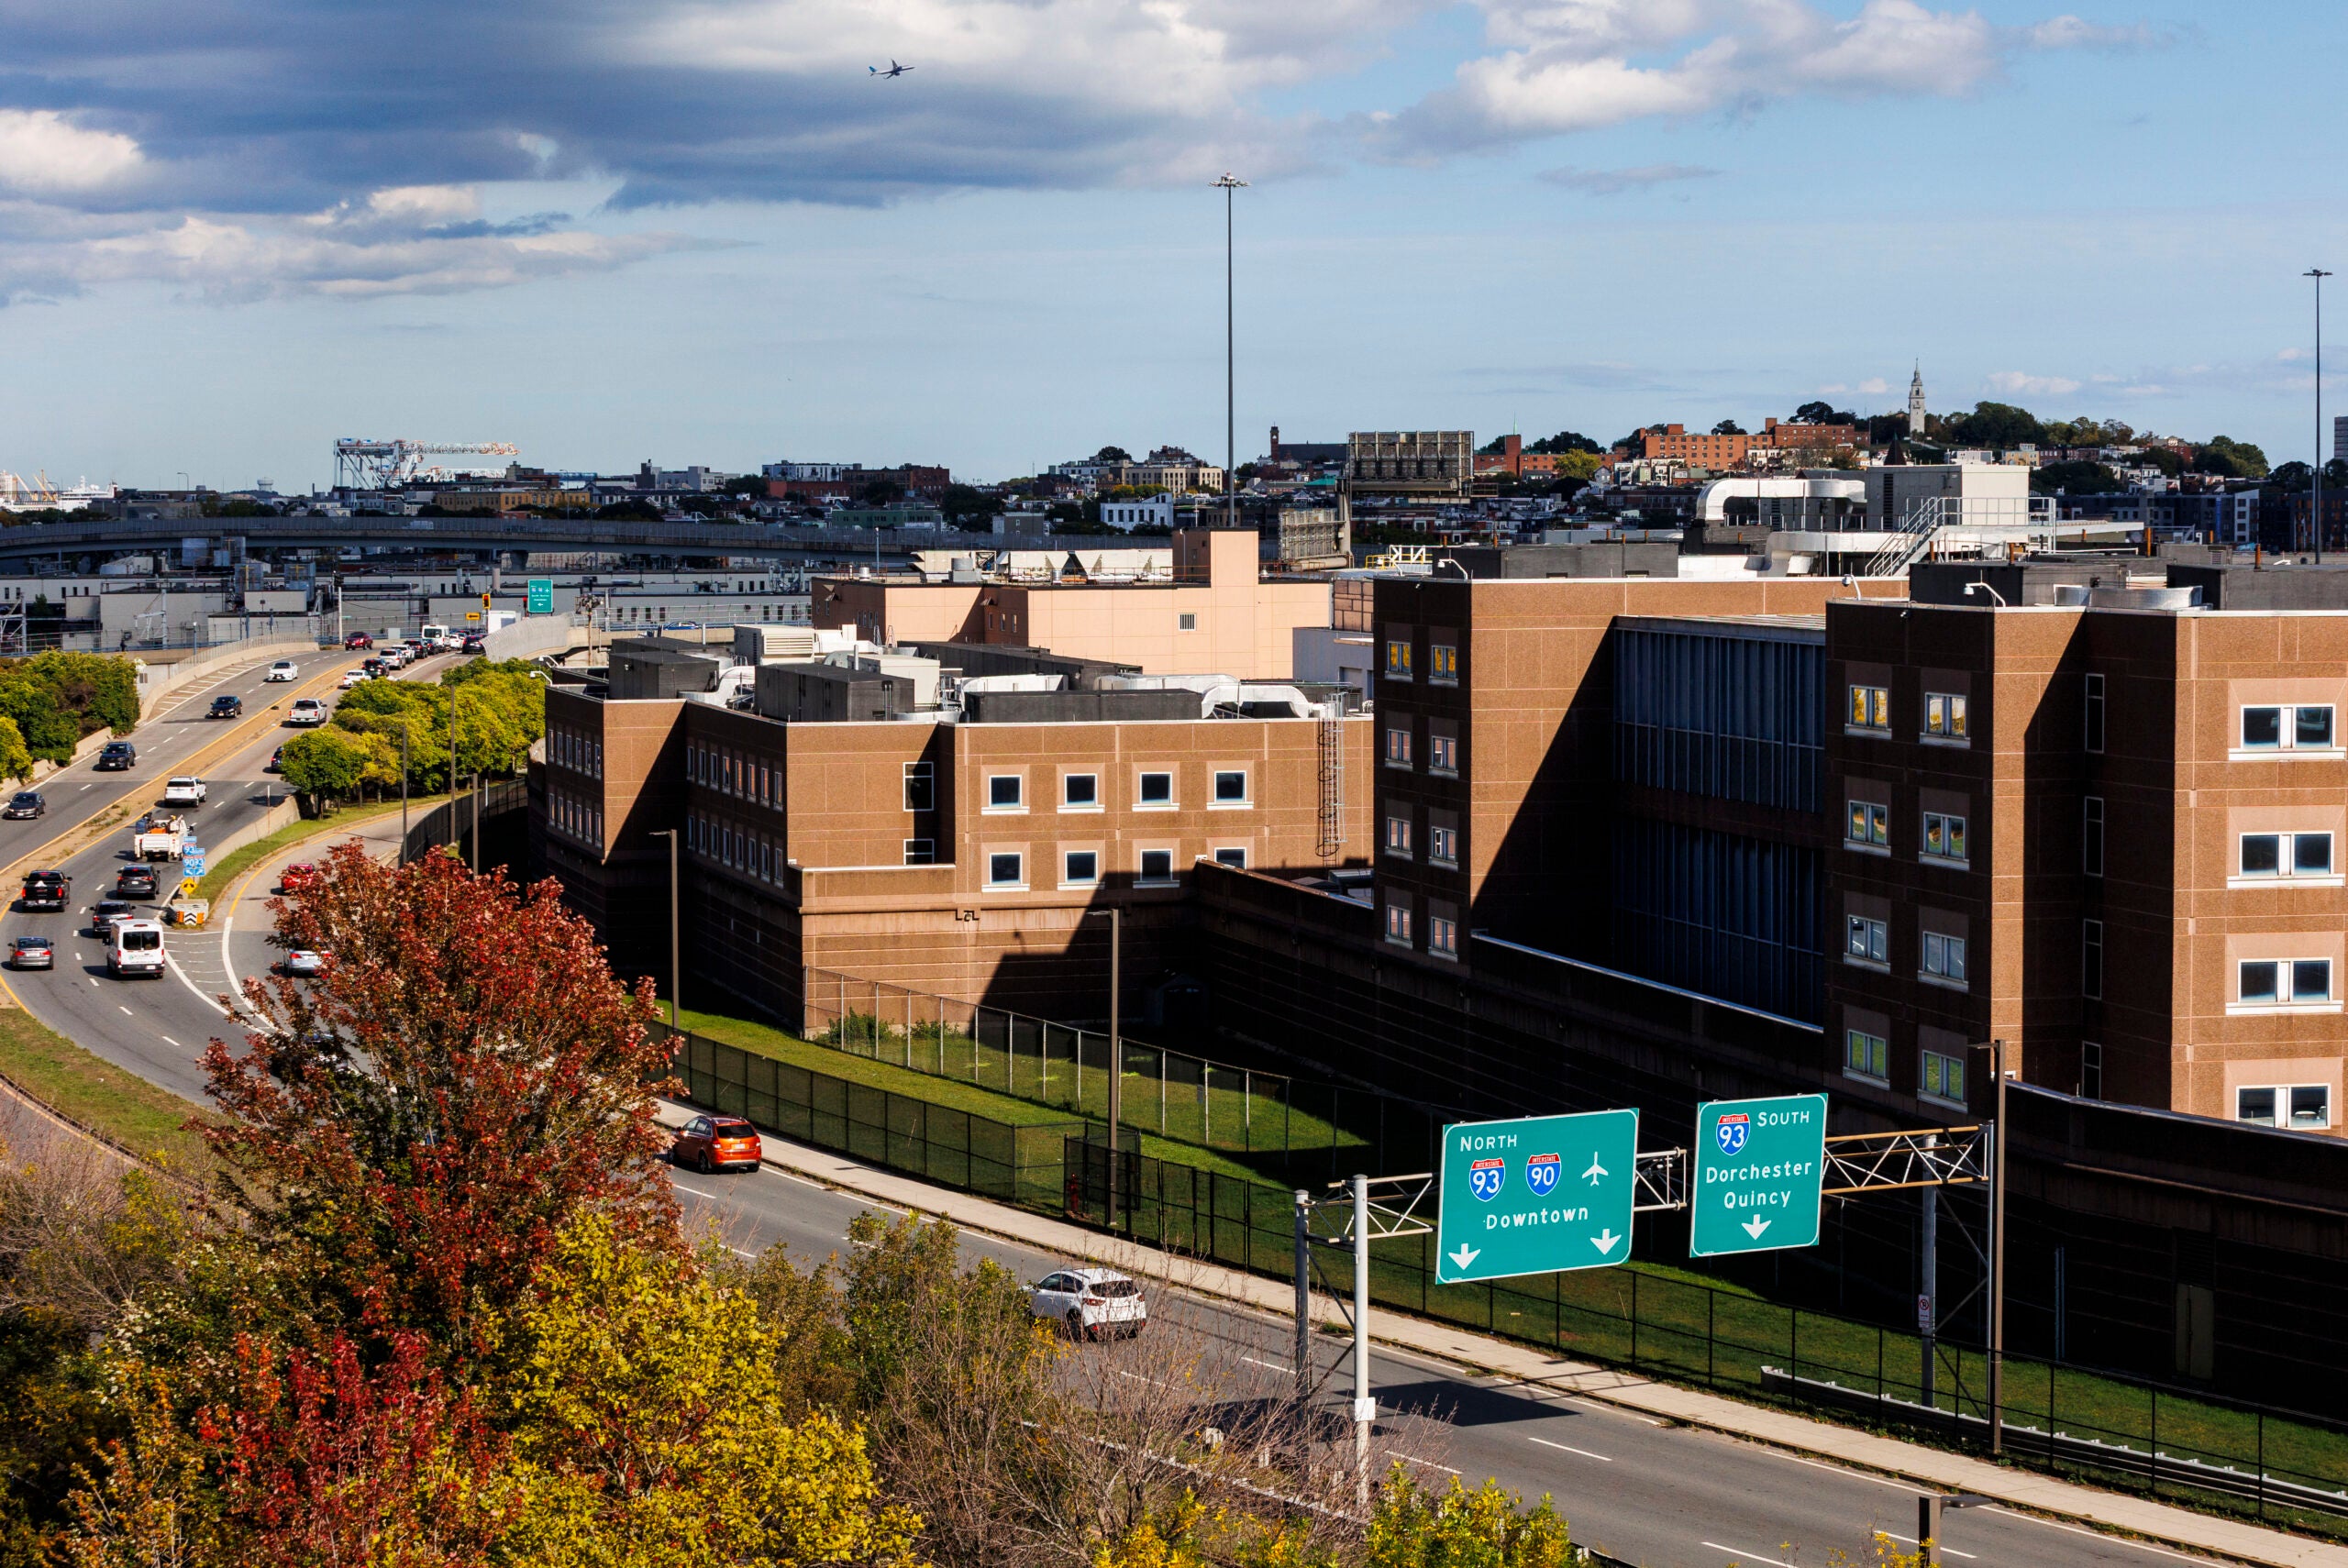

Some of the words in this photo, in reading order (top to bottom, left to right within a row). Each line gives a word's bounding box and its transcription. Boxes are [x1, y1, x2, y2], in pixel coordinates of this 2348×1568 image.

[1757, 1110, 1810, 1127] SOUTH
[1460, 1134, 1517, 1152] NORTH
[1719, 1125, 1744, 1148] 93
[1475, 1160, 1500, 1168] INTERSTATE
[1706, 1161, 1812, 1184] Dorchester
[1473, 1169, 1500, 1194] 93
[1531, 1165, 1555, 1187] 90
[1723, 1190, 1791, 1209] Quincy
[1486, 1206, 1589, 1231] Downtown
